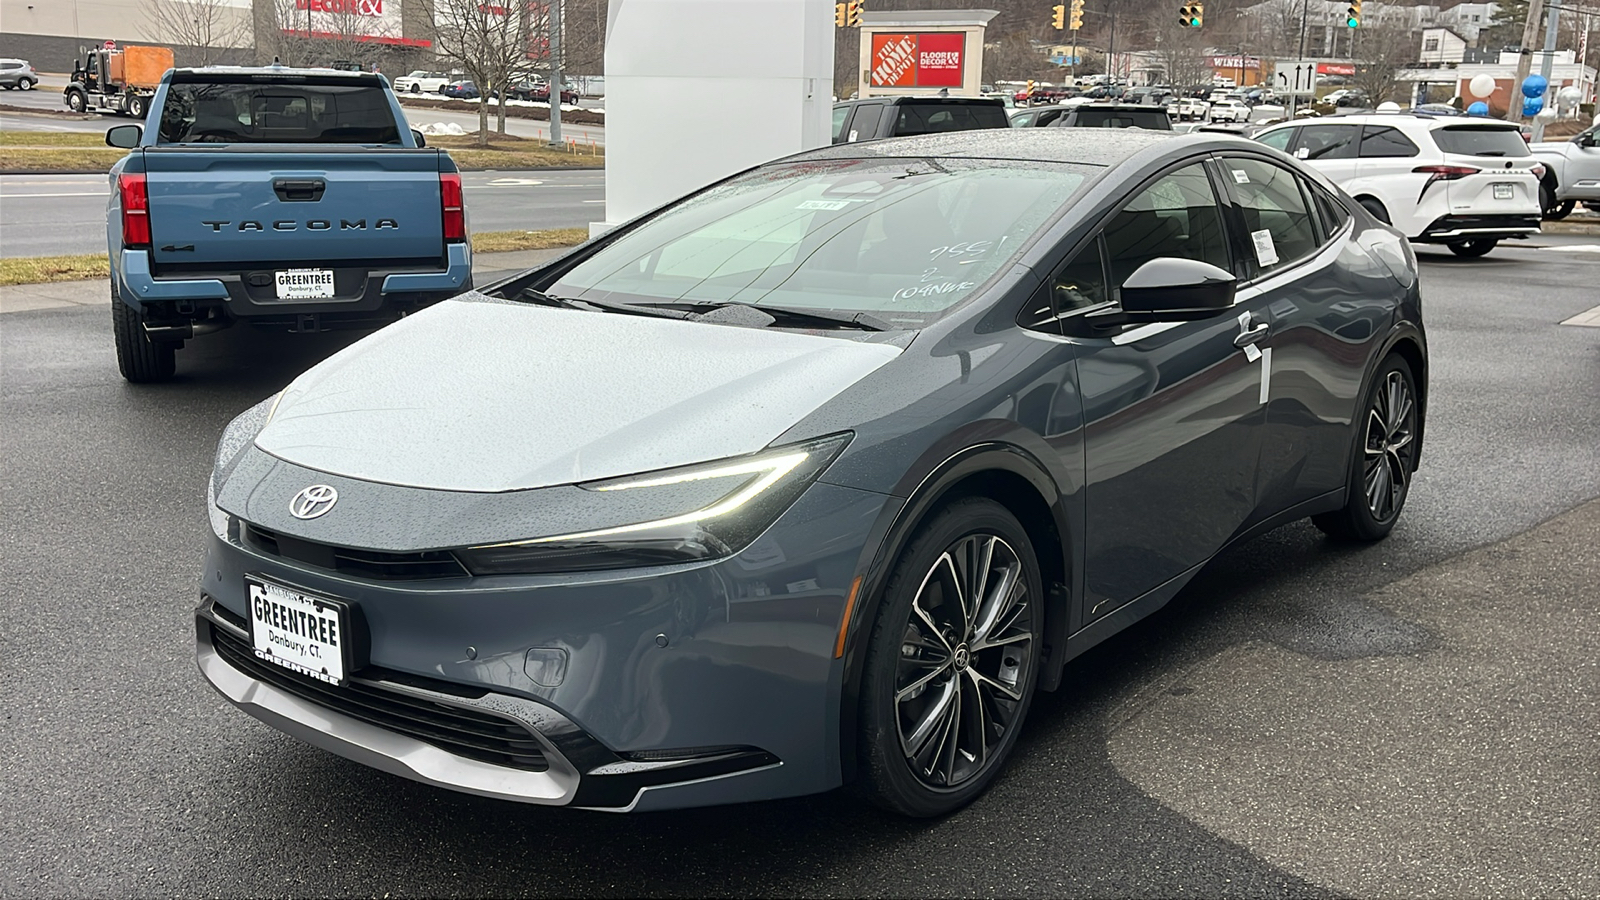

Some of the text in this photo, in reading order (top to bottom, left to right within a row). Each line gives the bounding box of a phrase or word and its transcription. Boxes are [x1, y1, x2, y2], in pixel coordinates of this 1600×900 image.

[872, 35, 916, 86] HOME
[876, 38, 897, 60] THE
[920, 51, 946, 59] FLOOR
[887, 53, 916, 86] DEPOT
[1213, 57, 1243, 68] WINES
[201, 218, 399, 233] TACOMA
[278, 274, 332, 286] GREENTREE
[254, 595, 337, 647] GREENTREE
[268, 629, 322, 659] Danbury, CT.
[254, 650, 340, 687] GREENTREE
